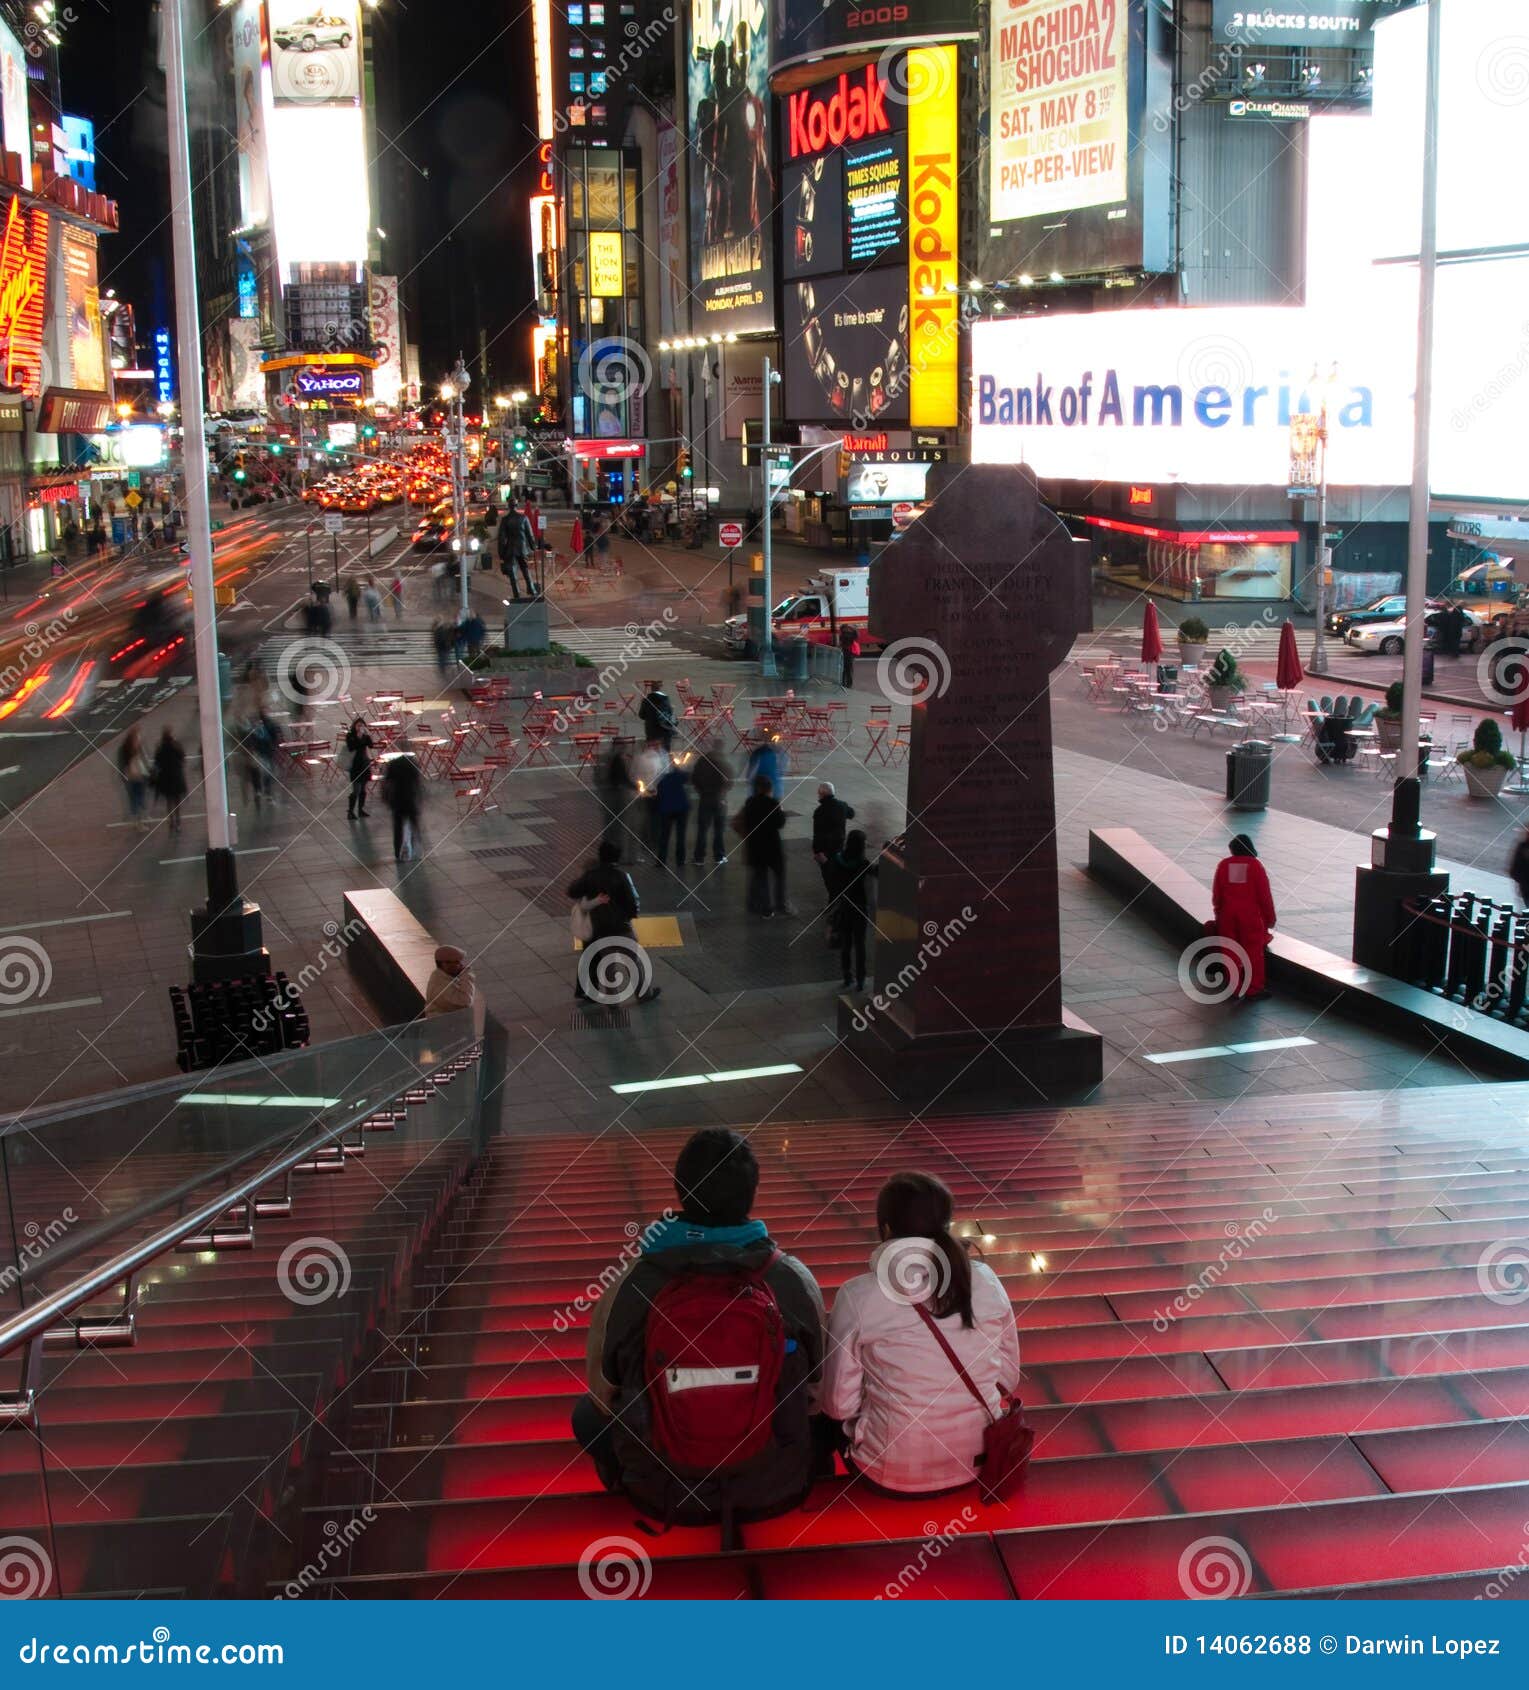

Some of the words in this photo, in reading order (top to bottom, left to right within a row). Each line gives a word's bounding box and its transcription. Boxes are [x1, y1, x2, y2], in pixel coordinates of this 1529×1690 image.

[847, 5, 909, 27] 2009
[1000, 2, 1099, 62] MACHIDA
[1101, 0, 1116, 70] 2
[1233, 13, 1243, 26] 2
[1247, 13, 1305, 29] BLOCKS
[1308, 16, 1360, 31] SOUTH
[1015, 35, 1099, 93] SHOGUN
[789, 63, 889, 157] Kodak
[1000, 106, 1033, 139] SAT.
[1040, 93, 1078, 130] MAY
[1084, 90, 1096, 119] 8
[847, 168, 869, 187] TIMES
[869, 159, 899, 182] SQUARE
[1001, 143, 1115, 191] PAY-PER-VIEW
[913, 153, 952, 331] Kodak
[755, 290, 763, 304] 19
[299, 377, 360, 391] YAHOO!
[978, 372, 1053, 427] Bank
[1060, 371, 1092, 427] of
